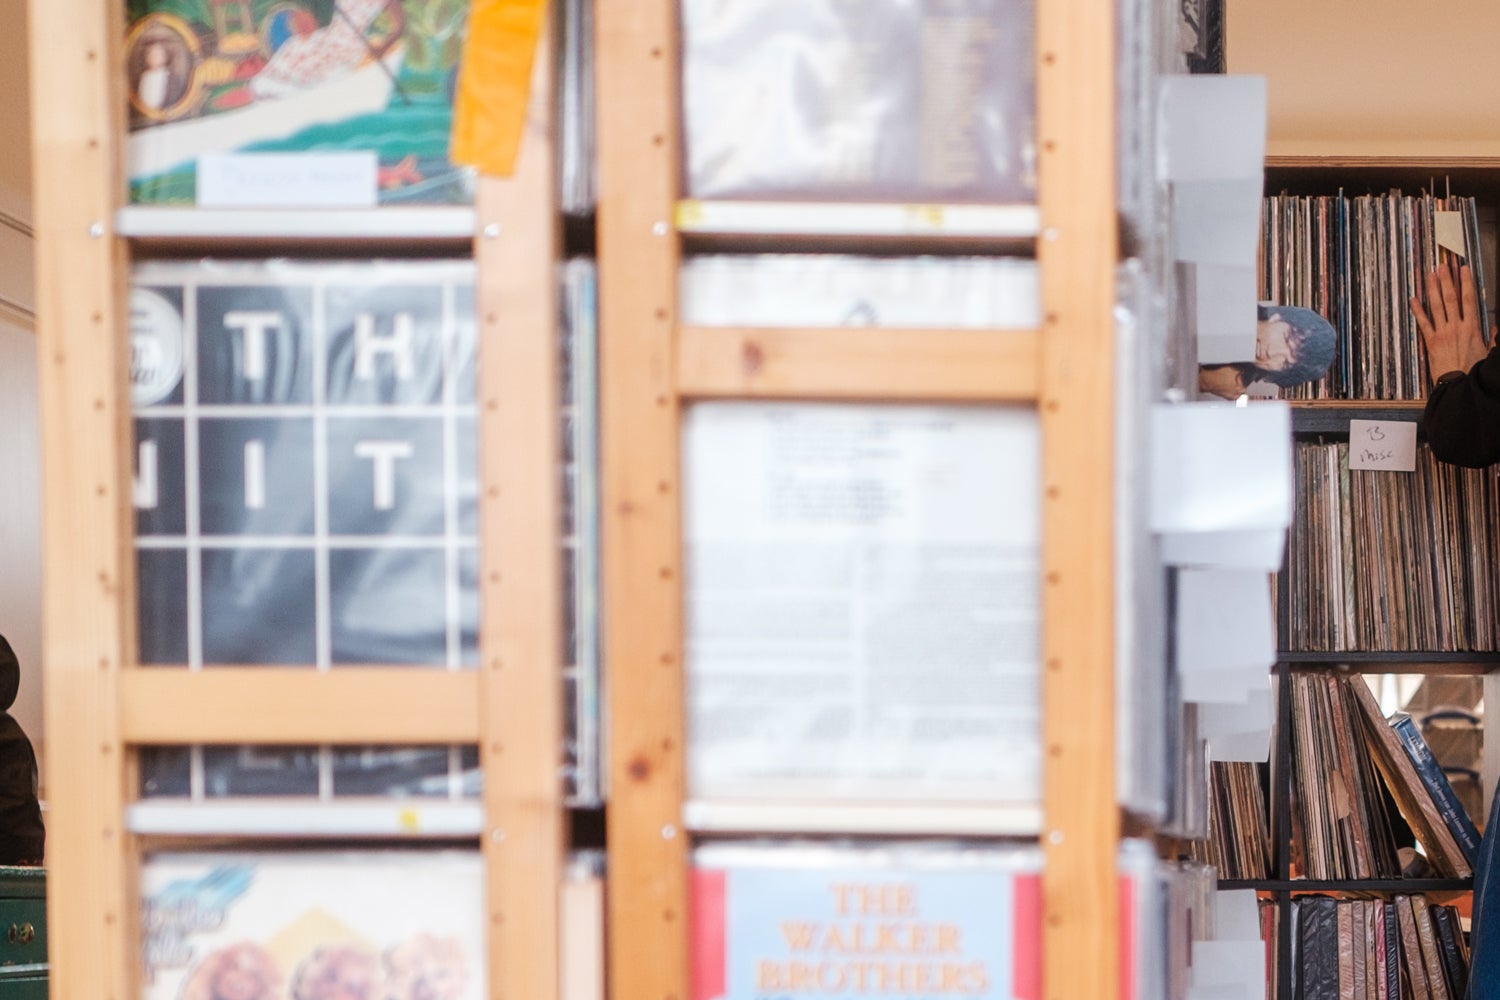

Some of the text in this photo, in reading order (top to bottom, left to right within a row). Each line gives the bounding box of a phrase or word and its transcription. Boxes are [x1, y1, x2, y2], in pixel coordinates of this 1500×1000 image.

[828, 882, 917, 915] THE
[780, 921, 962, 954] WALKER
[754, 958, 990, 993] BROTHERS
